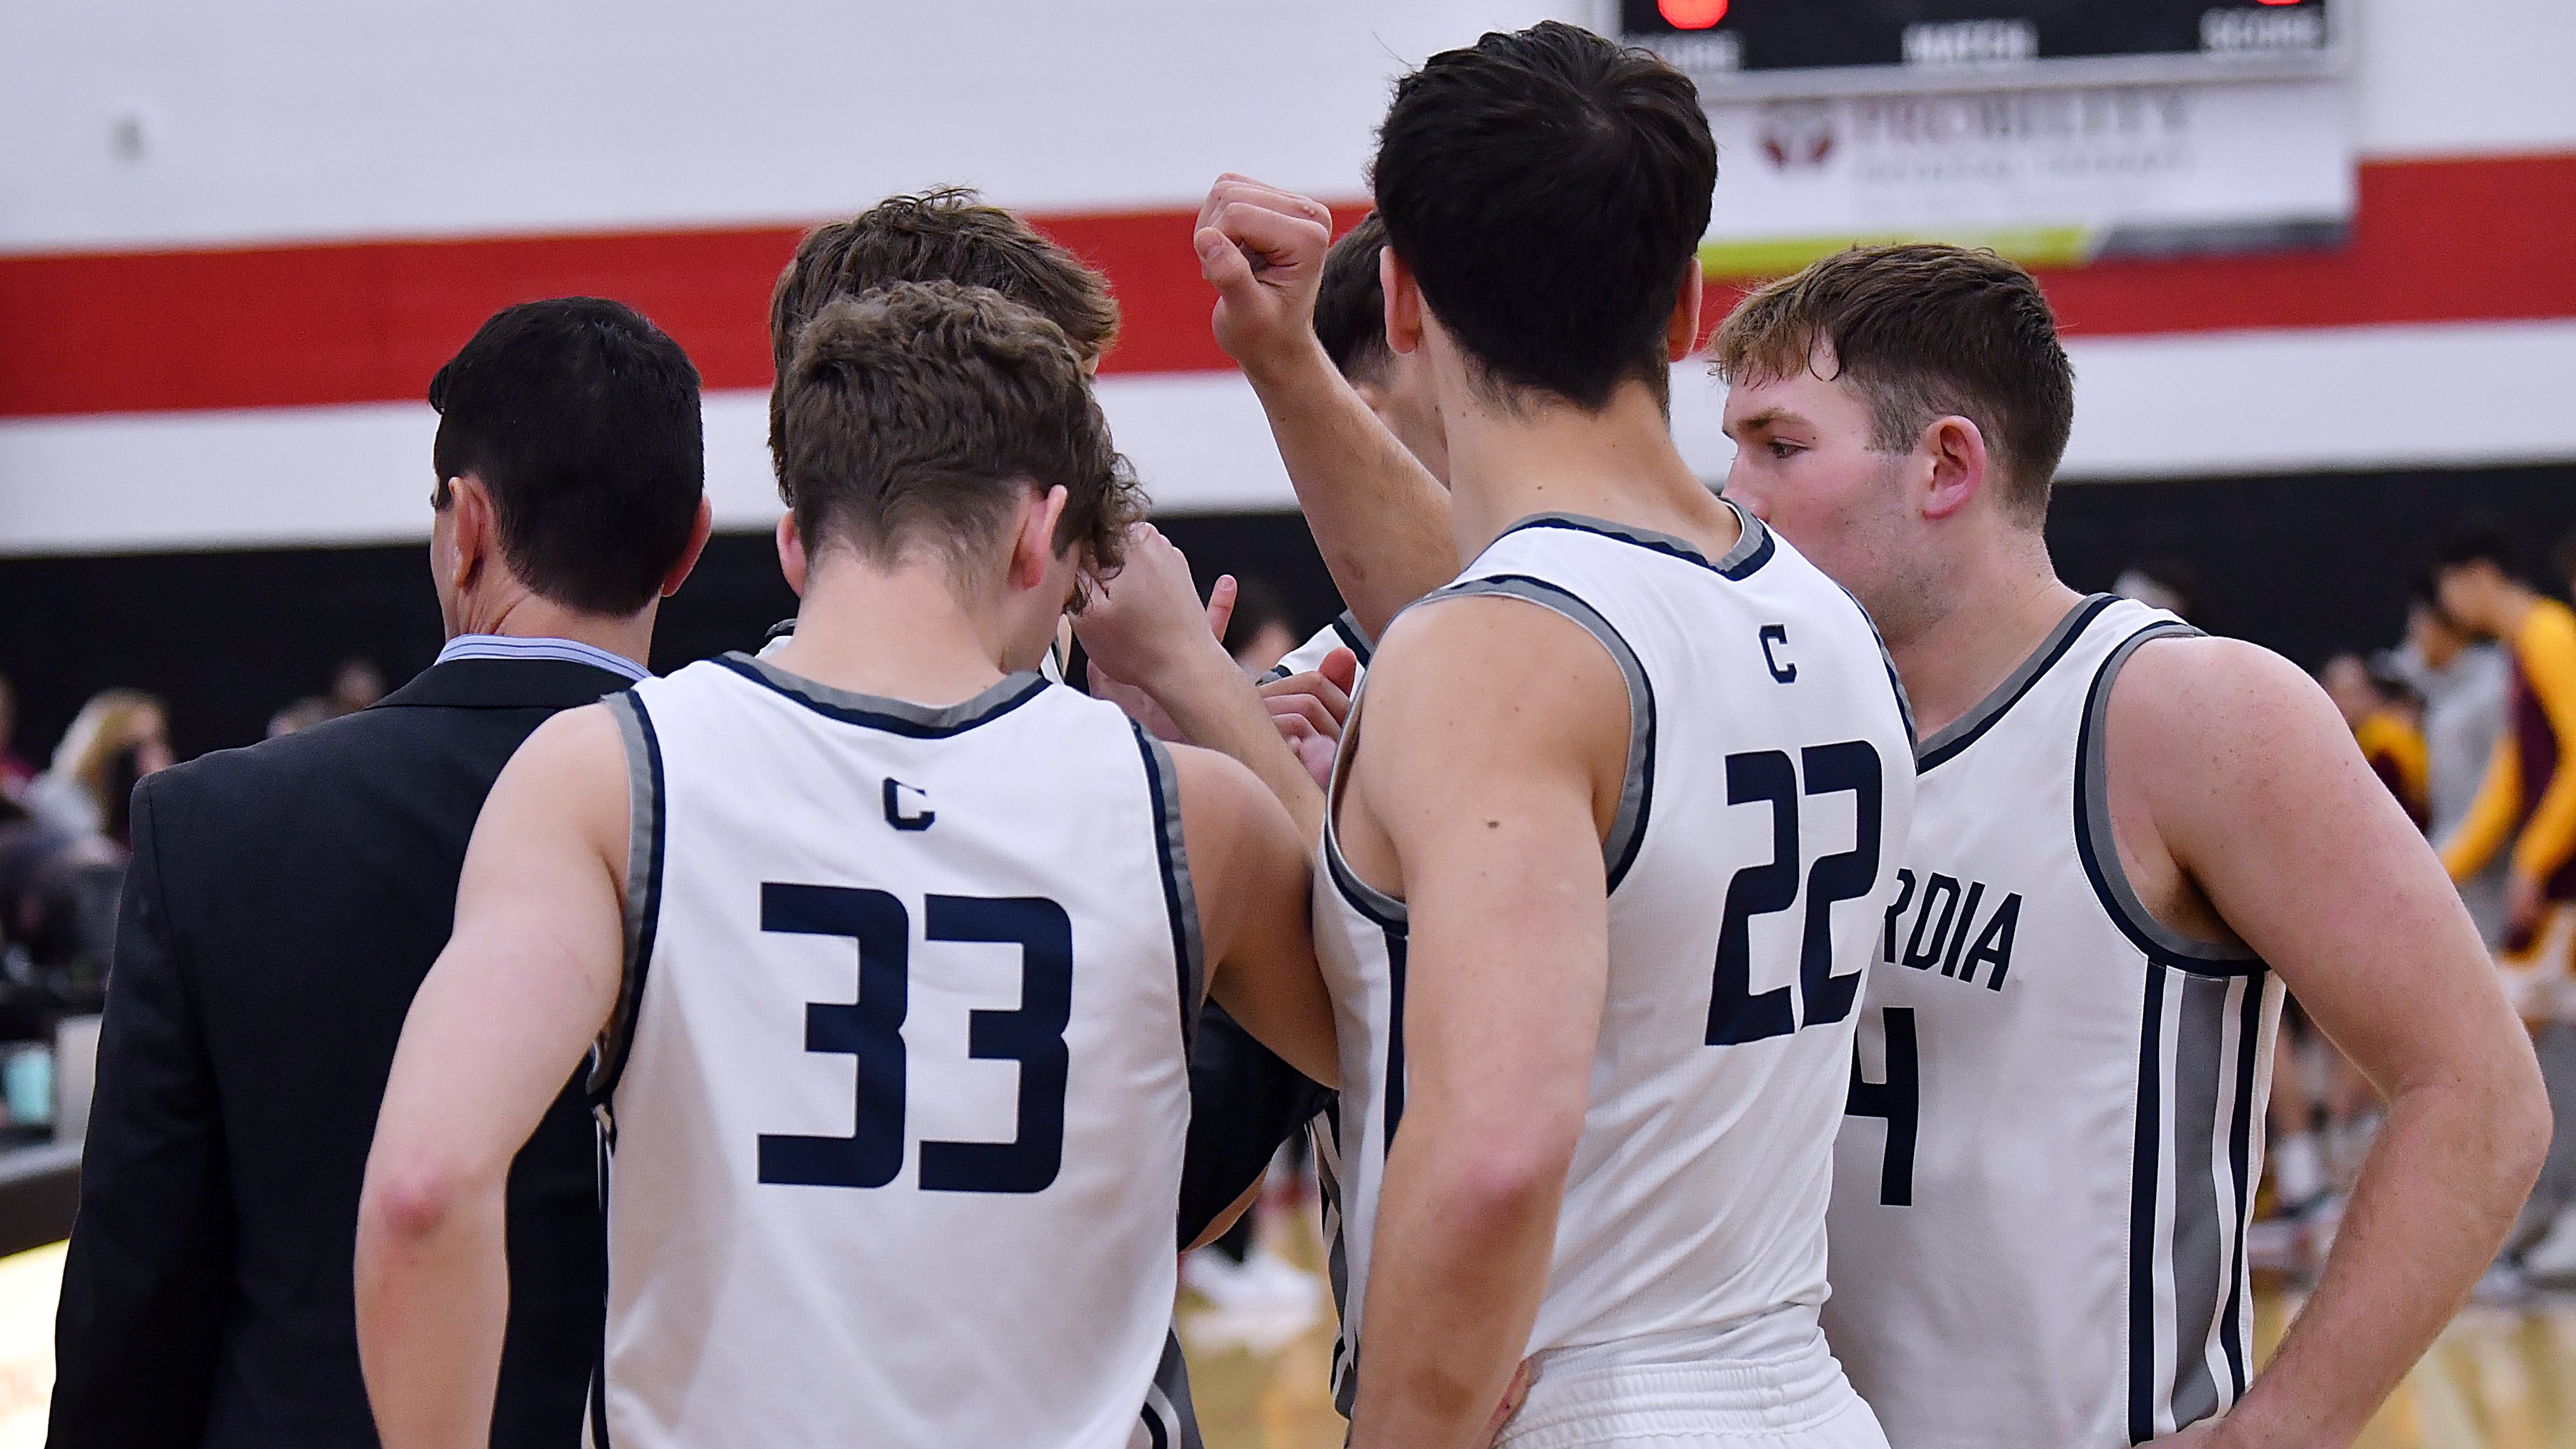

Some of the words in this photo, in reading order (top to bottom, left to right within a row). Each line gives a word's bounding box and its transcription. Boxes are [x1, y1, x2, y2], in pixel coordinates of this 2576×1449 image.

[1759, 624, 1797, 684] C
[883, 777, 935, 831] C
[1704, 741, 1883, 1045] 22
[757, 882, 1073, 1194] 33
